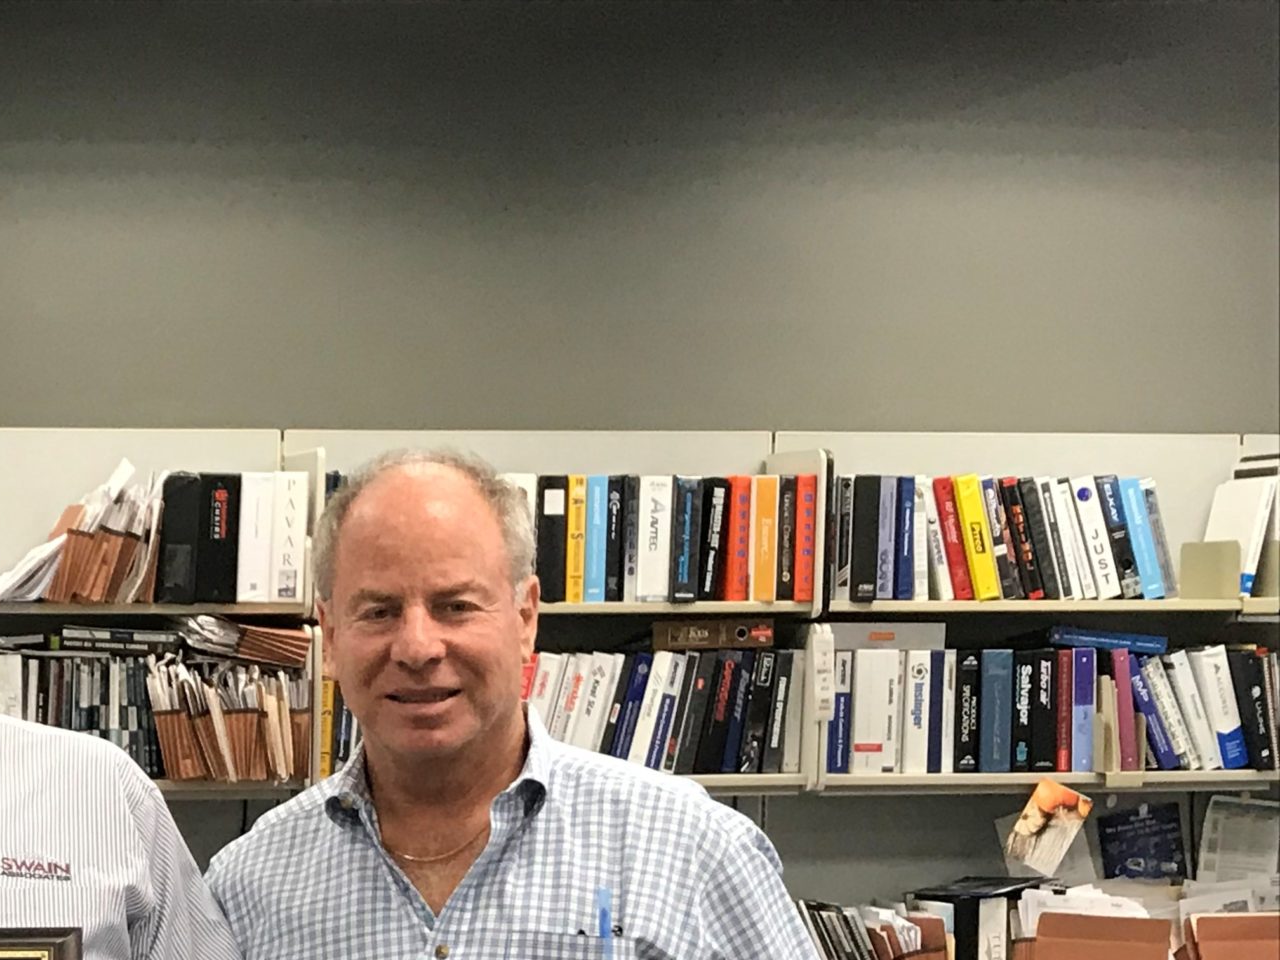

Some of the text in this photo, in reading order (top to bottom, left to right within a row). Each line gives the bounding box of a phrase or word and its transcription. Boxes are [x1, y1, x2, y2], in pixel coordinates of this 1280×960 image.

[1103, 483, 1120, 522] ELKAY
[1091, 528, 1112, 584] JUST
[911, 682, 925, 729] Insinger
[1016, 664, 1033, 726] Salvajor
[0, 857, 71, 875] SWAIN
[0, 871, 71, 882] ASSOCIATES
